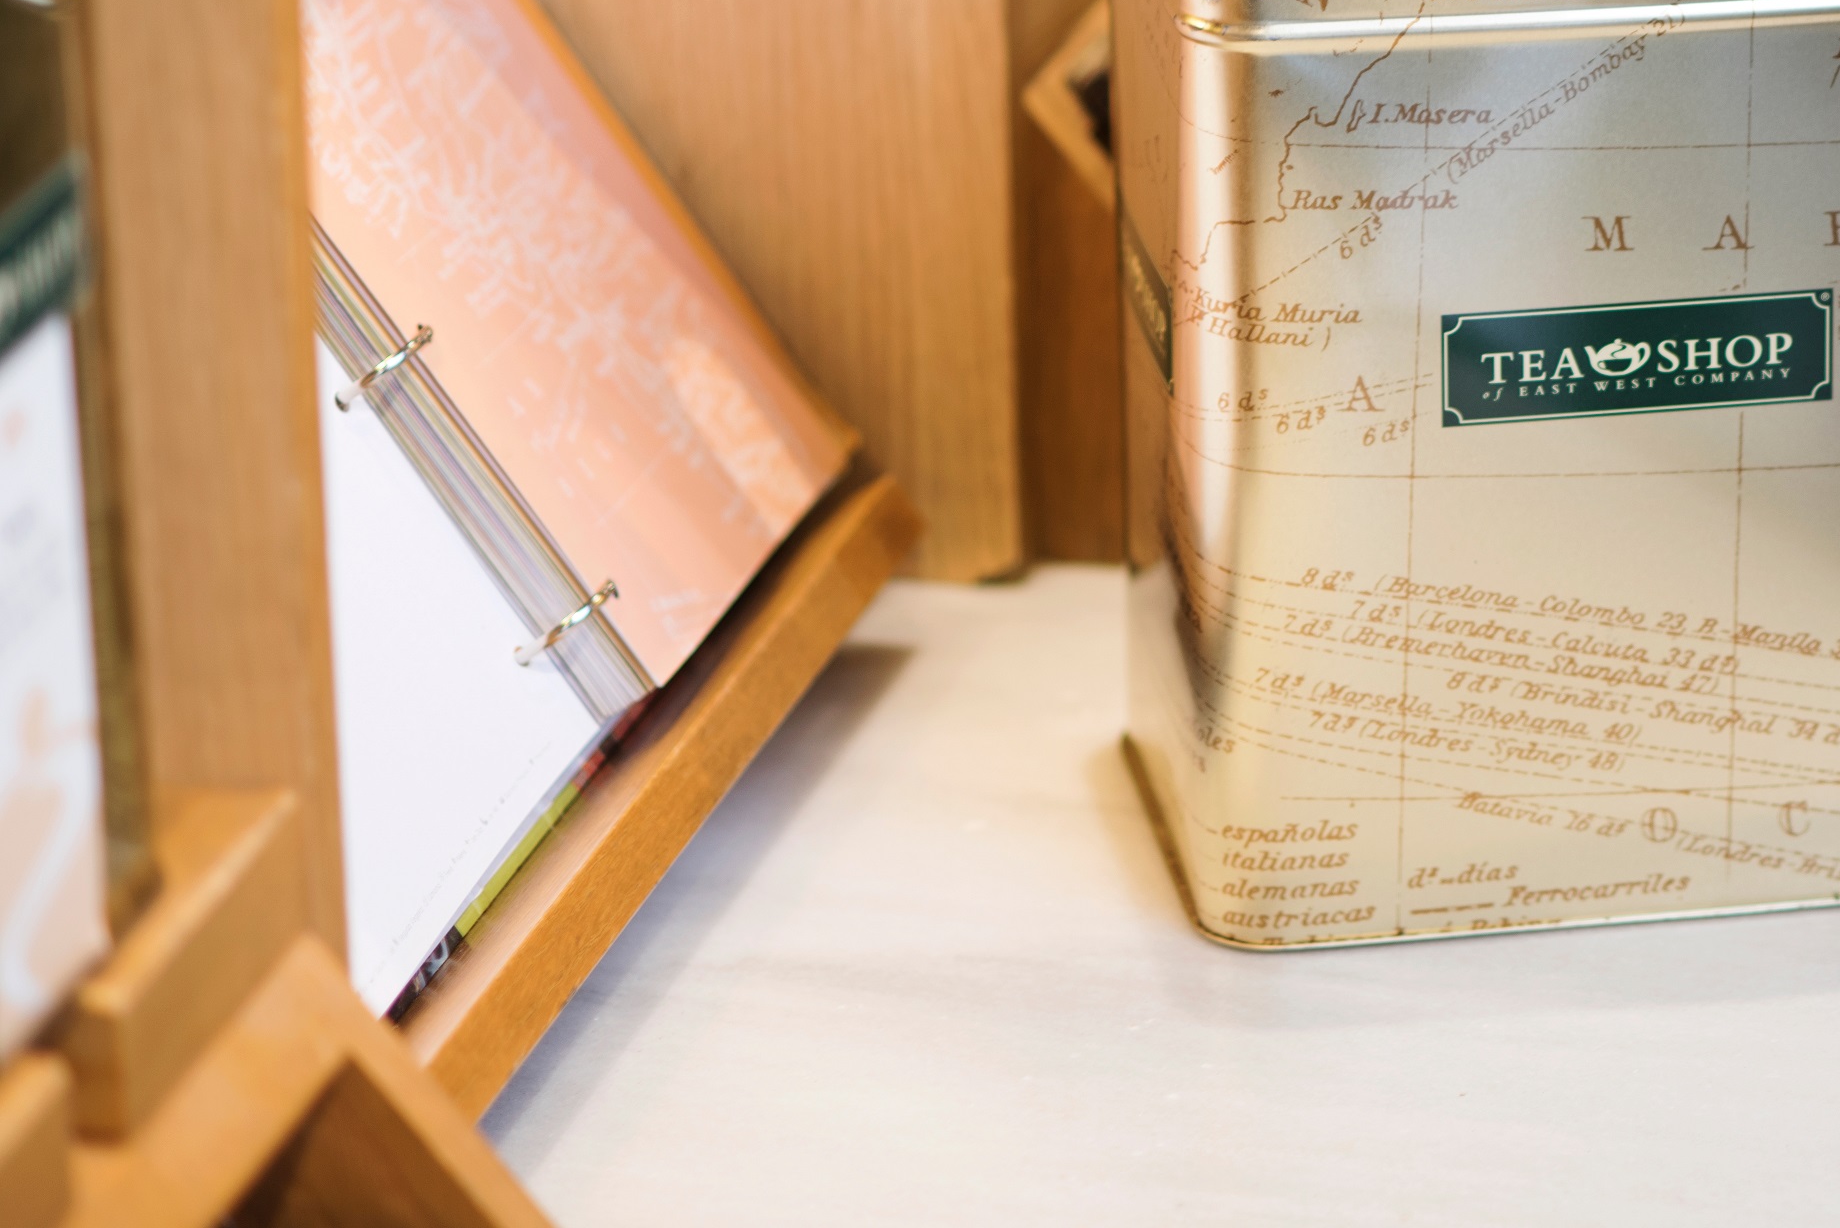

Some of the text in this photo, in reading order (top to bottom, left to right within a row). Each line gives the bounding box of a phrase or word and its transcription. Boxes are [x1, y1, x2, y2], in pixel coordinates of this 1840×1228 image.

[1293, 189, 1459, 212] Ras Madrak
[1271, 302, 1363, 324] Muria
[1481, 332, 1793, 385] TEA SHOP
[1336, 375, 1385, 412] A
[1482, 367, 1792, 402] of EAST WEST COMPANY
[1221, 820, 1359, 848] españolas
[1221, 849, 1350, 872] italianas
[1221, 878, 1360, 901] alemanas
[1503, 874, 1691, 908] Ferrocarriles
[1221, 905, 1377, 930] austriacas
